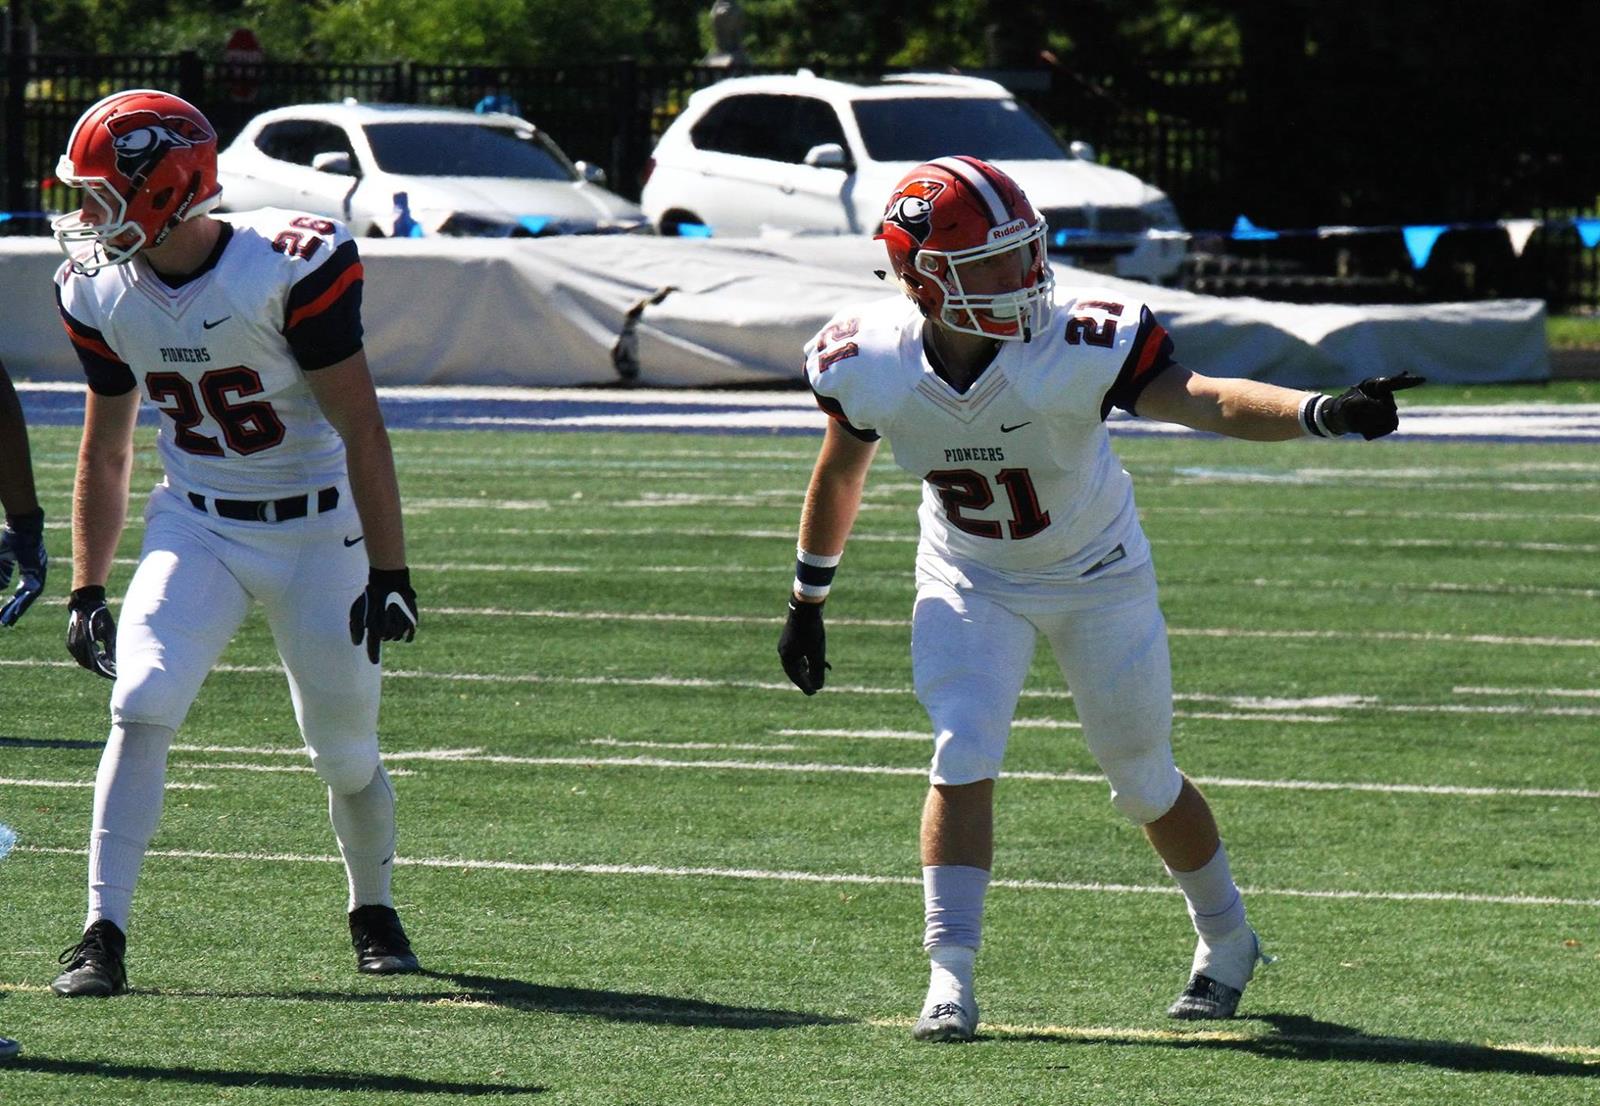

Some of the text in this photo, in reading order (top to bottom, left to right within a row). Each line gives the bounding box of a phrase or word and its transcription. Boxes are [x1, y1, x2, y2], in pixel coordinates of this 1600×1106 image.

[272, 216, 337, 262] 26
[992, 221, 1026, 239] Riddell
[817, 317, 860, 374] 21
[1064, 300, 1124, 349] 21
[160, 347, 212, 363] PIONEERS
[145, 364, 287, 458] 26
[944, 447, 1005, 462] PIONEERS
[924, 468, 1052, 540] 21
